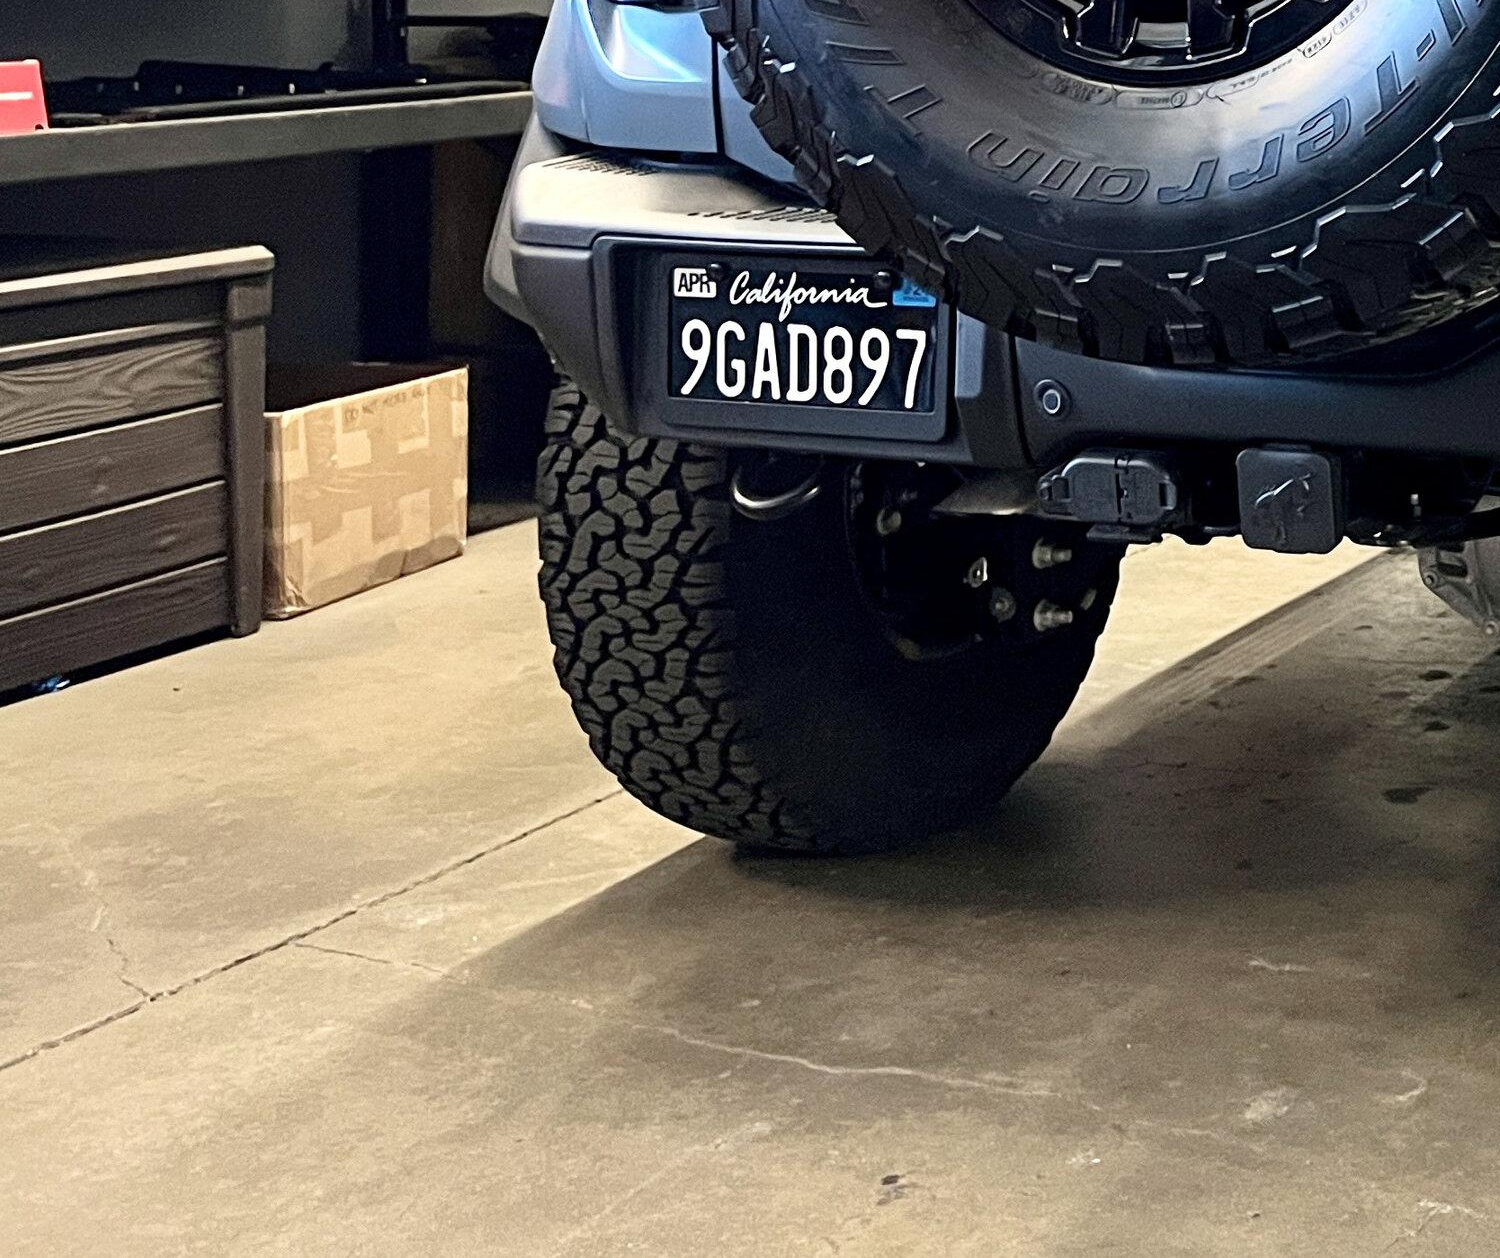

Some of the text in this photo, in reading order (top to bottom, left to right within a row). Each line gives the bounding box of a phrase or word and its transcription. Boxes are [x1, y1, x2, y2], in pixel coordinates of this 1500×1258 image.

[677, 272, 711, 294] APR
[729, 270, 888, 322] California
[680, 318, 928, 410] 9GAD897
